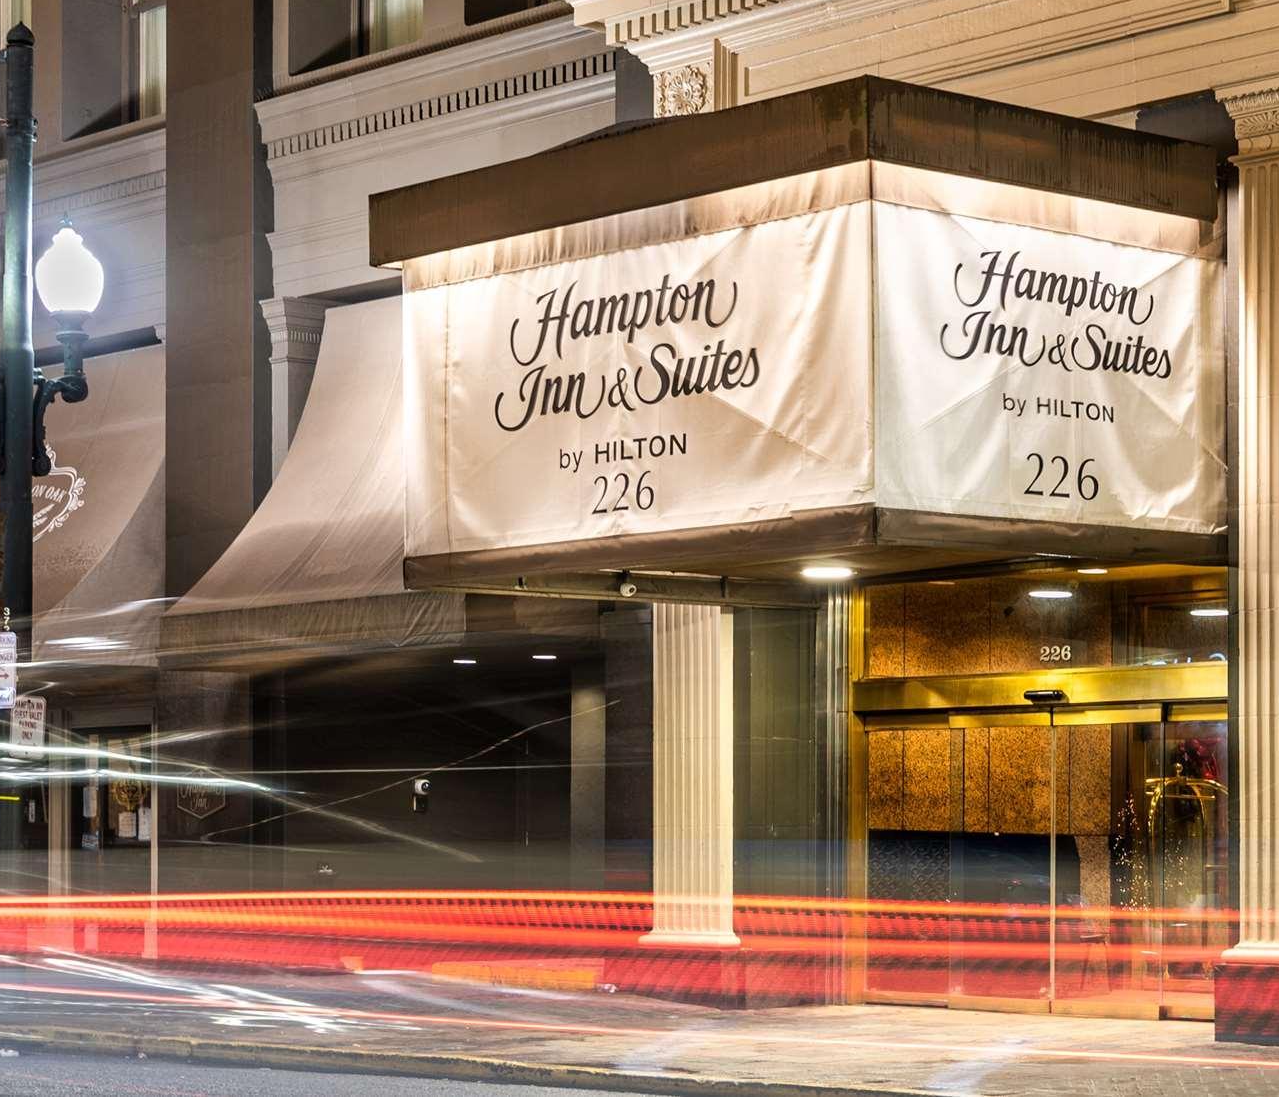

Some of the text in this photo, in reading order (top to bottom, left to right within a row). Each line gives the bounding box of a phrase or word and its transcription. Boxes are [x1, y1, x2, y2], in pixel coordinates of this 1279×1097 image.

[954, 250, 1154, 326] Hampton
[510, 273, 738, 366] Hampton
[940, 310, 1172, 379] Inn & Suites
[494, 339, 761, 432] Inn & Suites
[1002, 393, 1115, 423] by HILTON
[559, 433, 688, 473] by HILTON
[1023, 452, 1100, 501] 226
[45, 487, 66, 503] OAK
[591, 470, 655, 515] 226
[1039, 644, 1072, 662] 226
